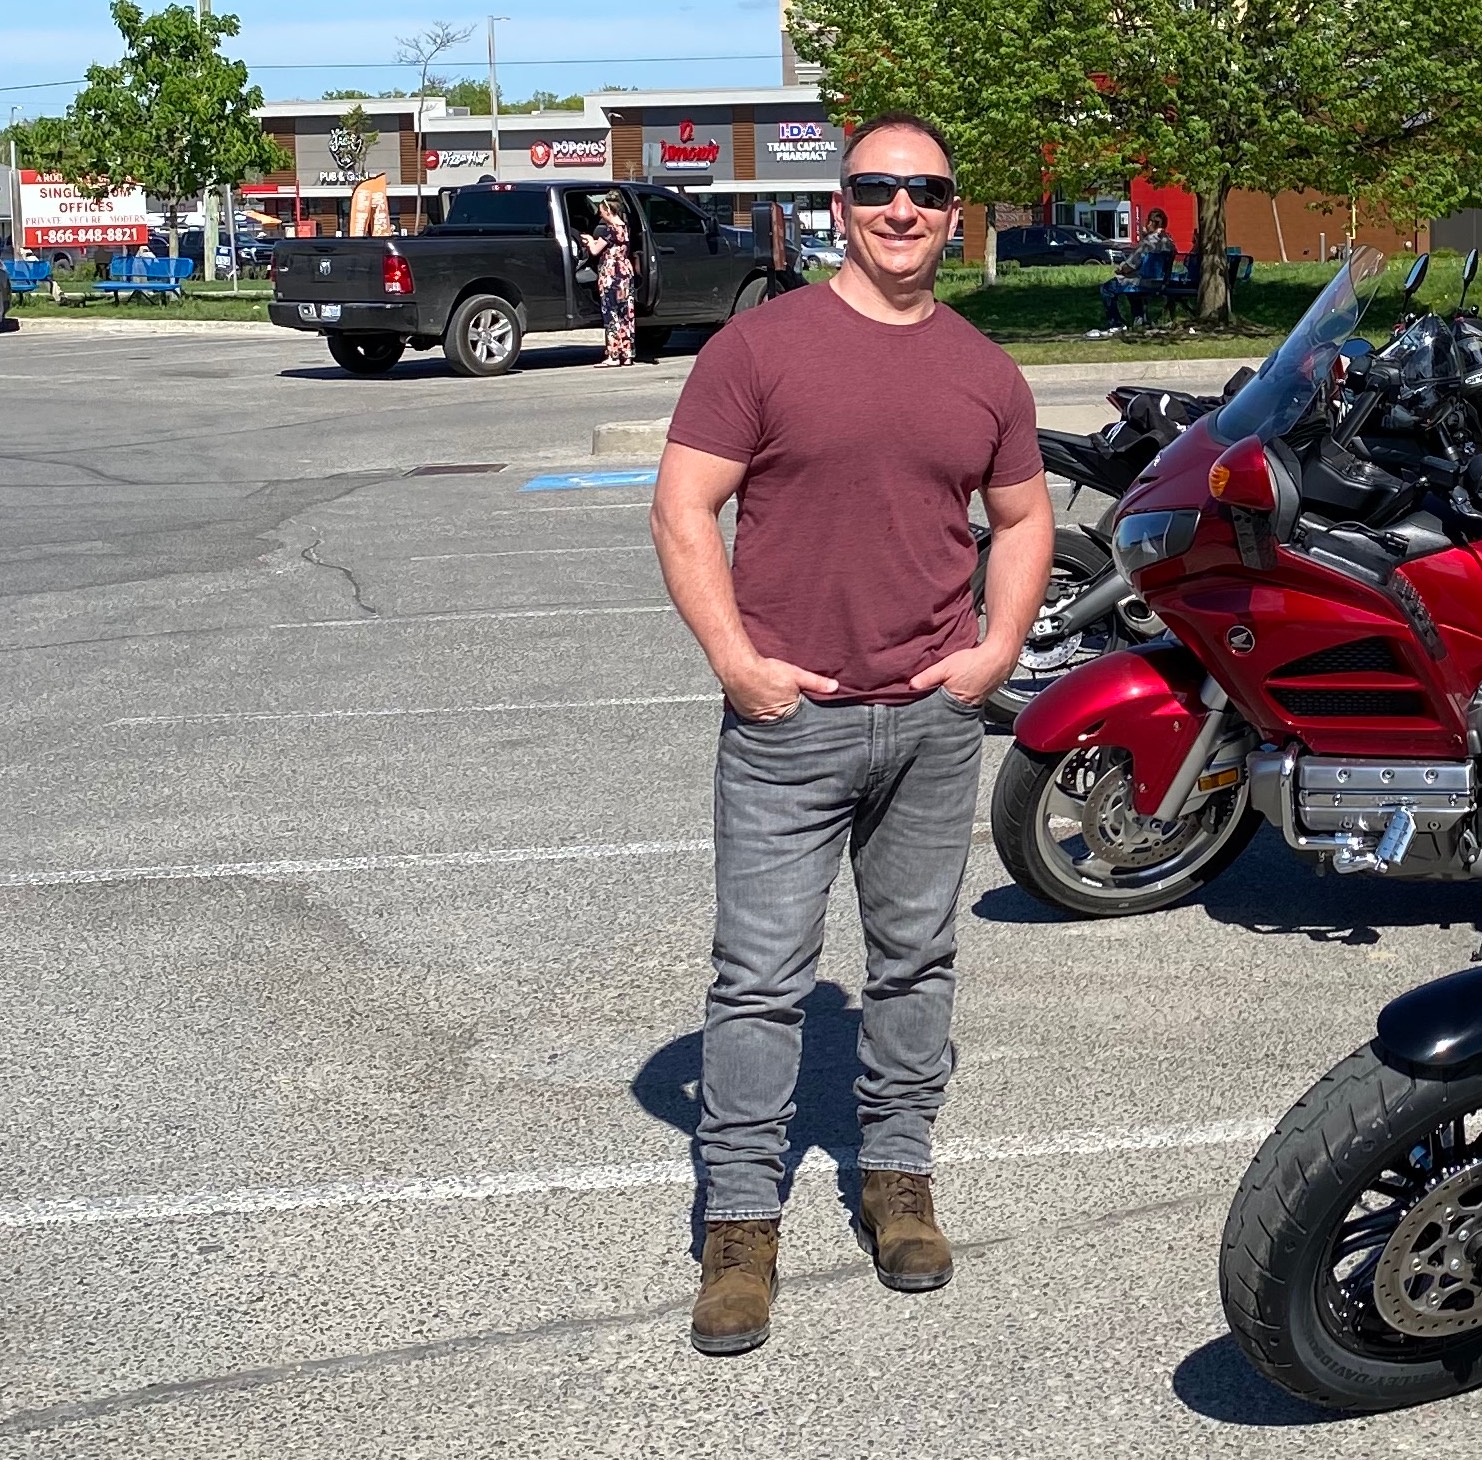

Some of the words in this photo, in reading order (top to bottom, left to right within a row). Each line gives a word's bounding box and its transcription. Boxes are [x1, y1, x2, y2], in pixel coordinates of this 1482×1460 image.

[767, 142, 795, 151] TRAIL
[797, 141, 837, 151] CAPITAL
[439, 151, 467, 168] Pizza
[467, 151, 490, 167] Hut
[776, 151, 828, 161] PHARMACY
[320, 171, 338, 181] PUB
[40, 188, 83, 198] SINGL
[59, 201, 114, 213] OFFICES
[25, 216, 61, 226] PRIVATE
[69, 216, 101, 225] SECURE
[109, 214, 146, 223] MODERN
[35, 227, 138, 244] 1-866-848-8821
